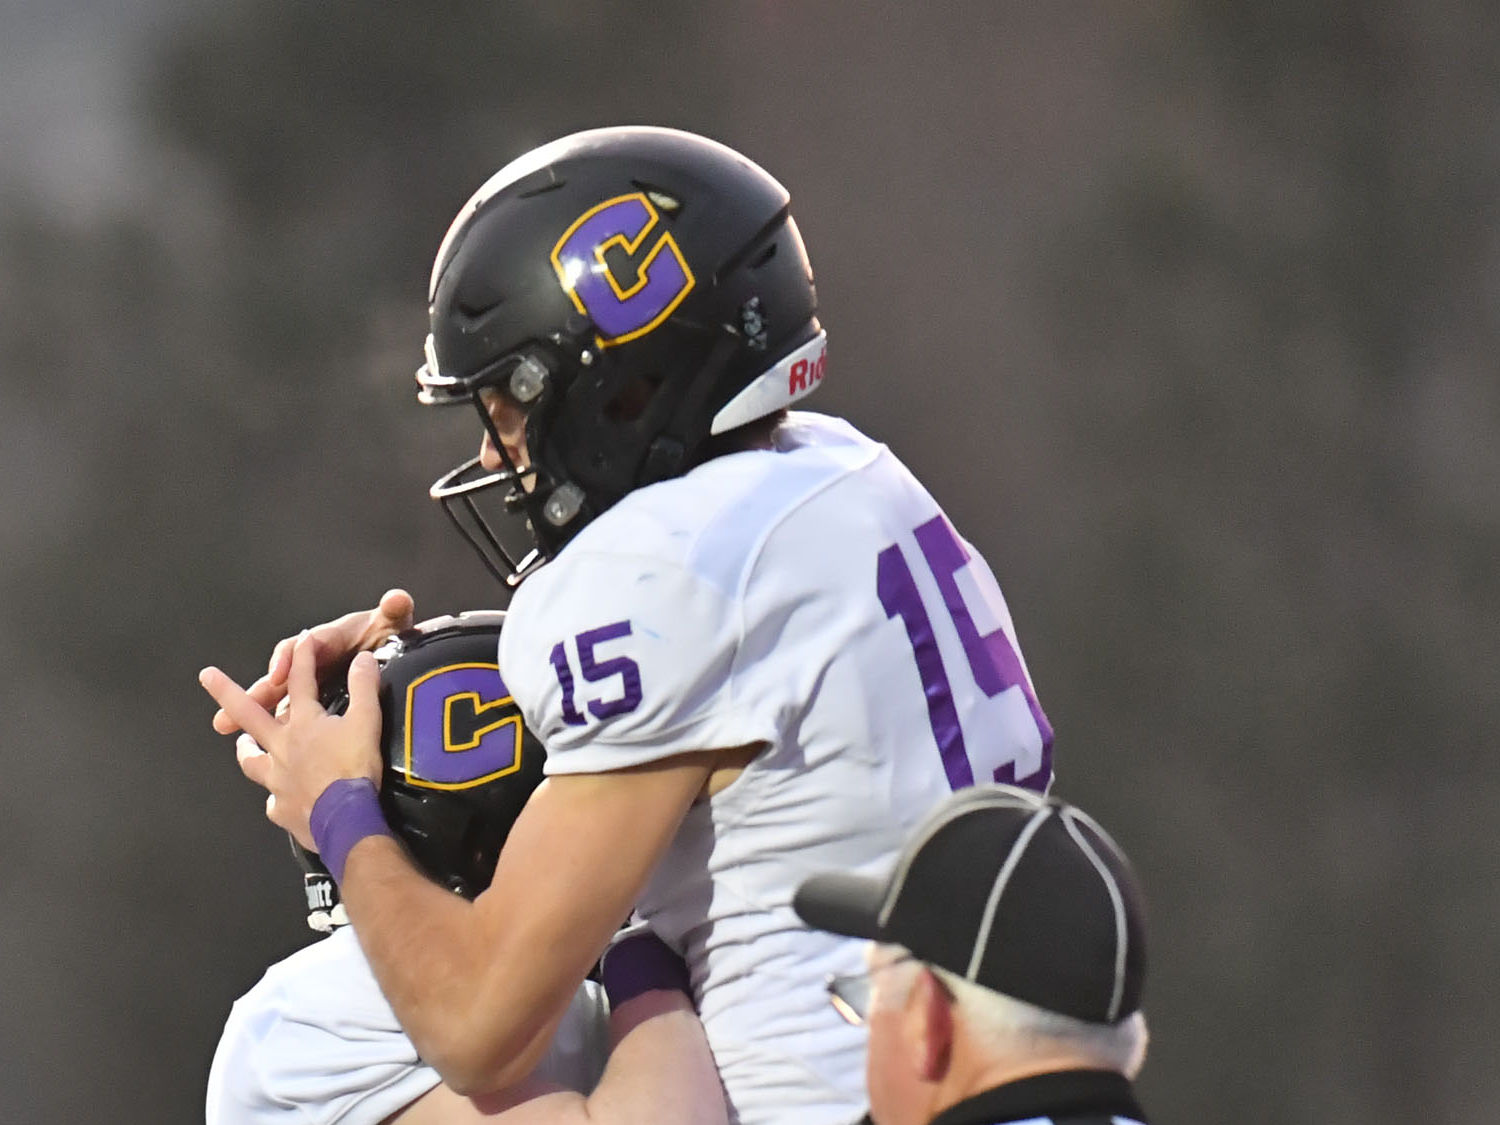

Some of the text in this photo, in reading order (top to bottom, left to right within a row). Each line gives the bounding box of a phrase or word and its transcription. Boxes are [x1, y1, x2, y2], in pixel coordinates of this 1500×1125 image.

[550, 192, 696, 349] C
[548, 618, 643, 726] 15
[876, 513, 1055, 793] 15
[404, 662, 524, 791] C
